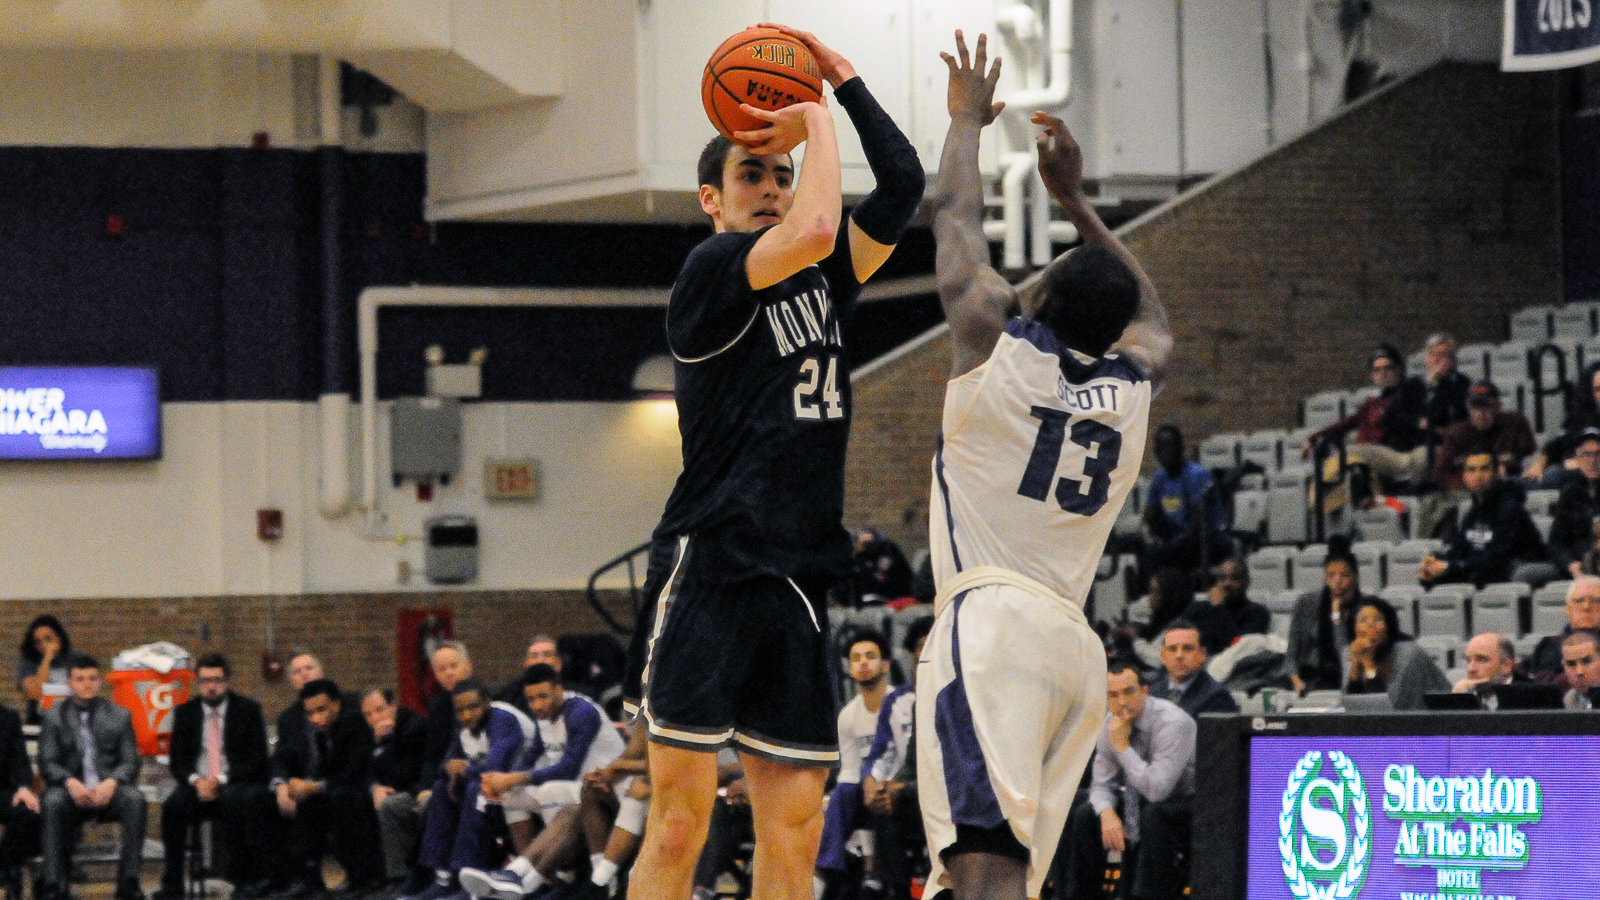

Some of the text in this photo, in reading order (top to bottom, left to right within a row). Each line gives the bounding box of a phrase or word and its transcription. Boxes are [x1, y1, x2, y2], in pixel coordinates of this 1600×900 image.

[752, 43, 796, 69] ROCK
[794, 357, 843, 419] 24
[1057, 374, 1119, 412] SCOTT
[1017, 405, 1122, 517] 13
[1382, 763, 1540, 815] Sheraton
[1393, 820, 1527, 858] At The Falls
[1436, 868, 1480, 889] HOTEL
